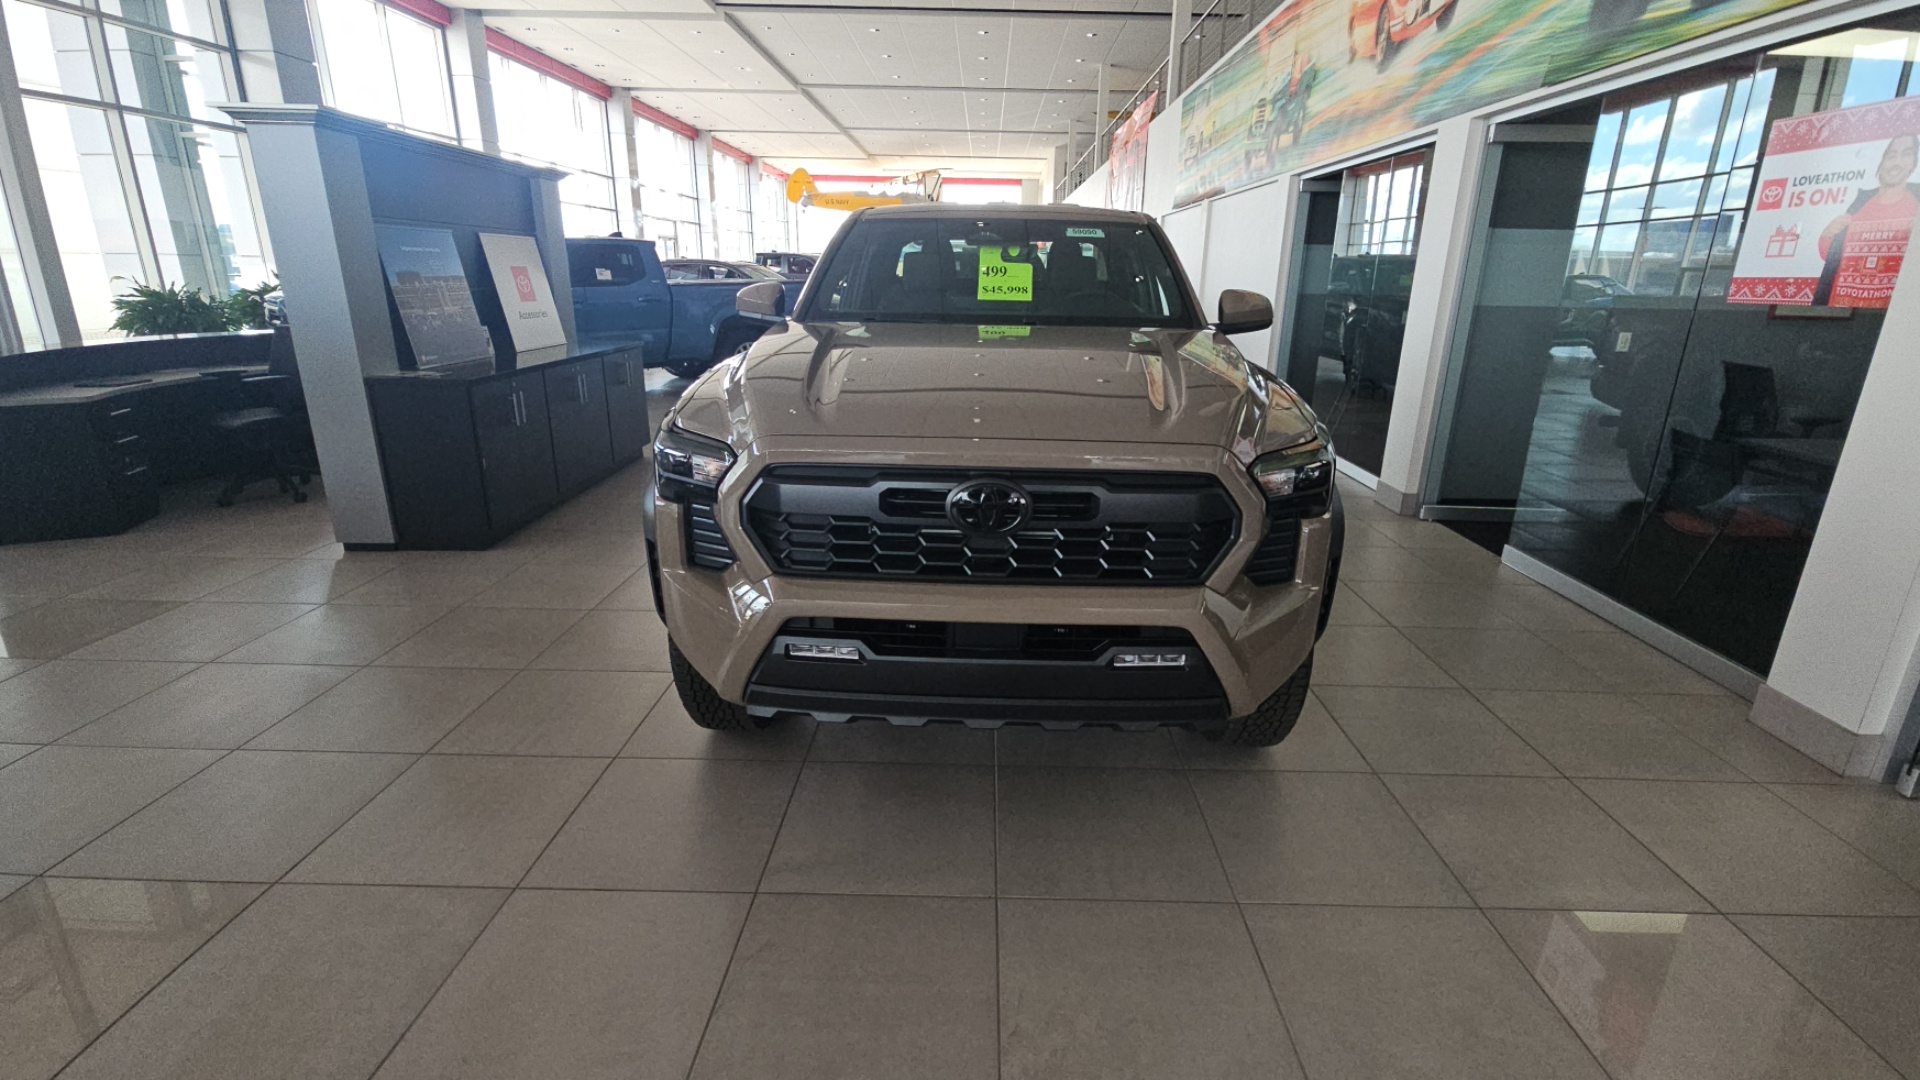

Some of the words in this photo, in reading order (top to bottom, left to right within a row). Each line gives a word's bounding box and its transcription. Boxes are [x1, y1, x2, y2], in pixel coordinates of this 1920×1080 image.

[1792, 169, 1866, 187] LOVEATHON
[1788, 191, 1805, 208] IS
[1809, 187, 1849, 207] ON!
[1862, 231, 1895, 241] MERRY
[982, 265, 1008, 277] 499
[981, 285, 1029, 295] $45,998
[1836, 286, 1894, 298] TOYOTATHON
[518, 309, 549, 321] Accessories
